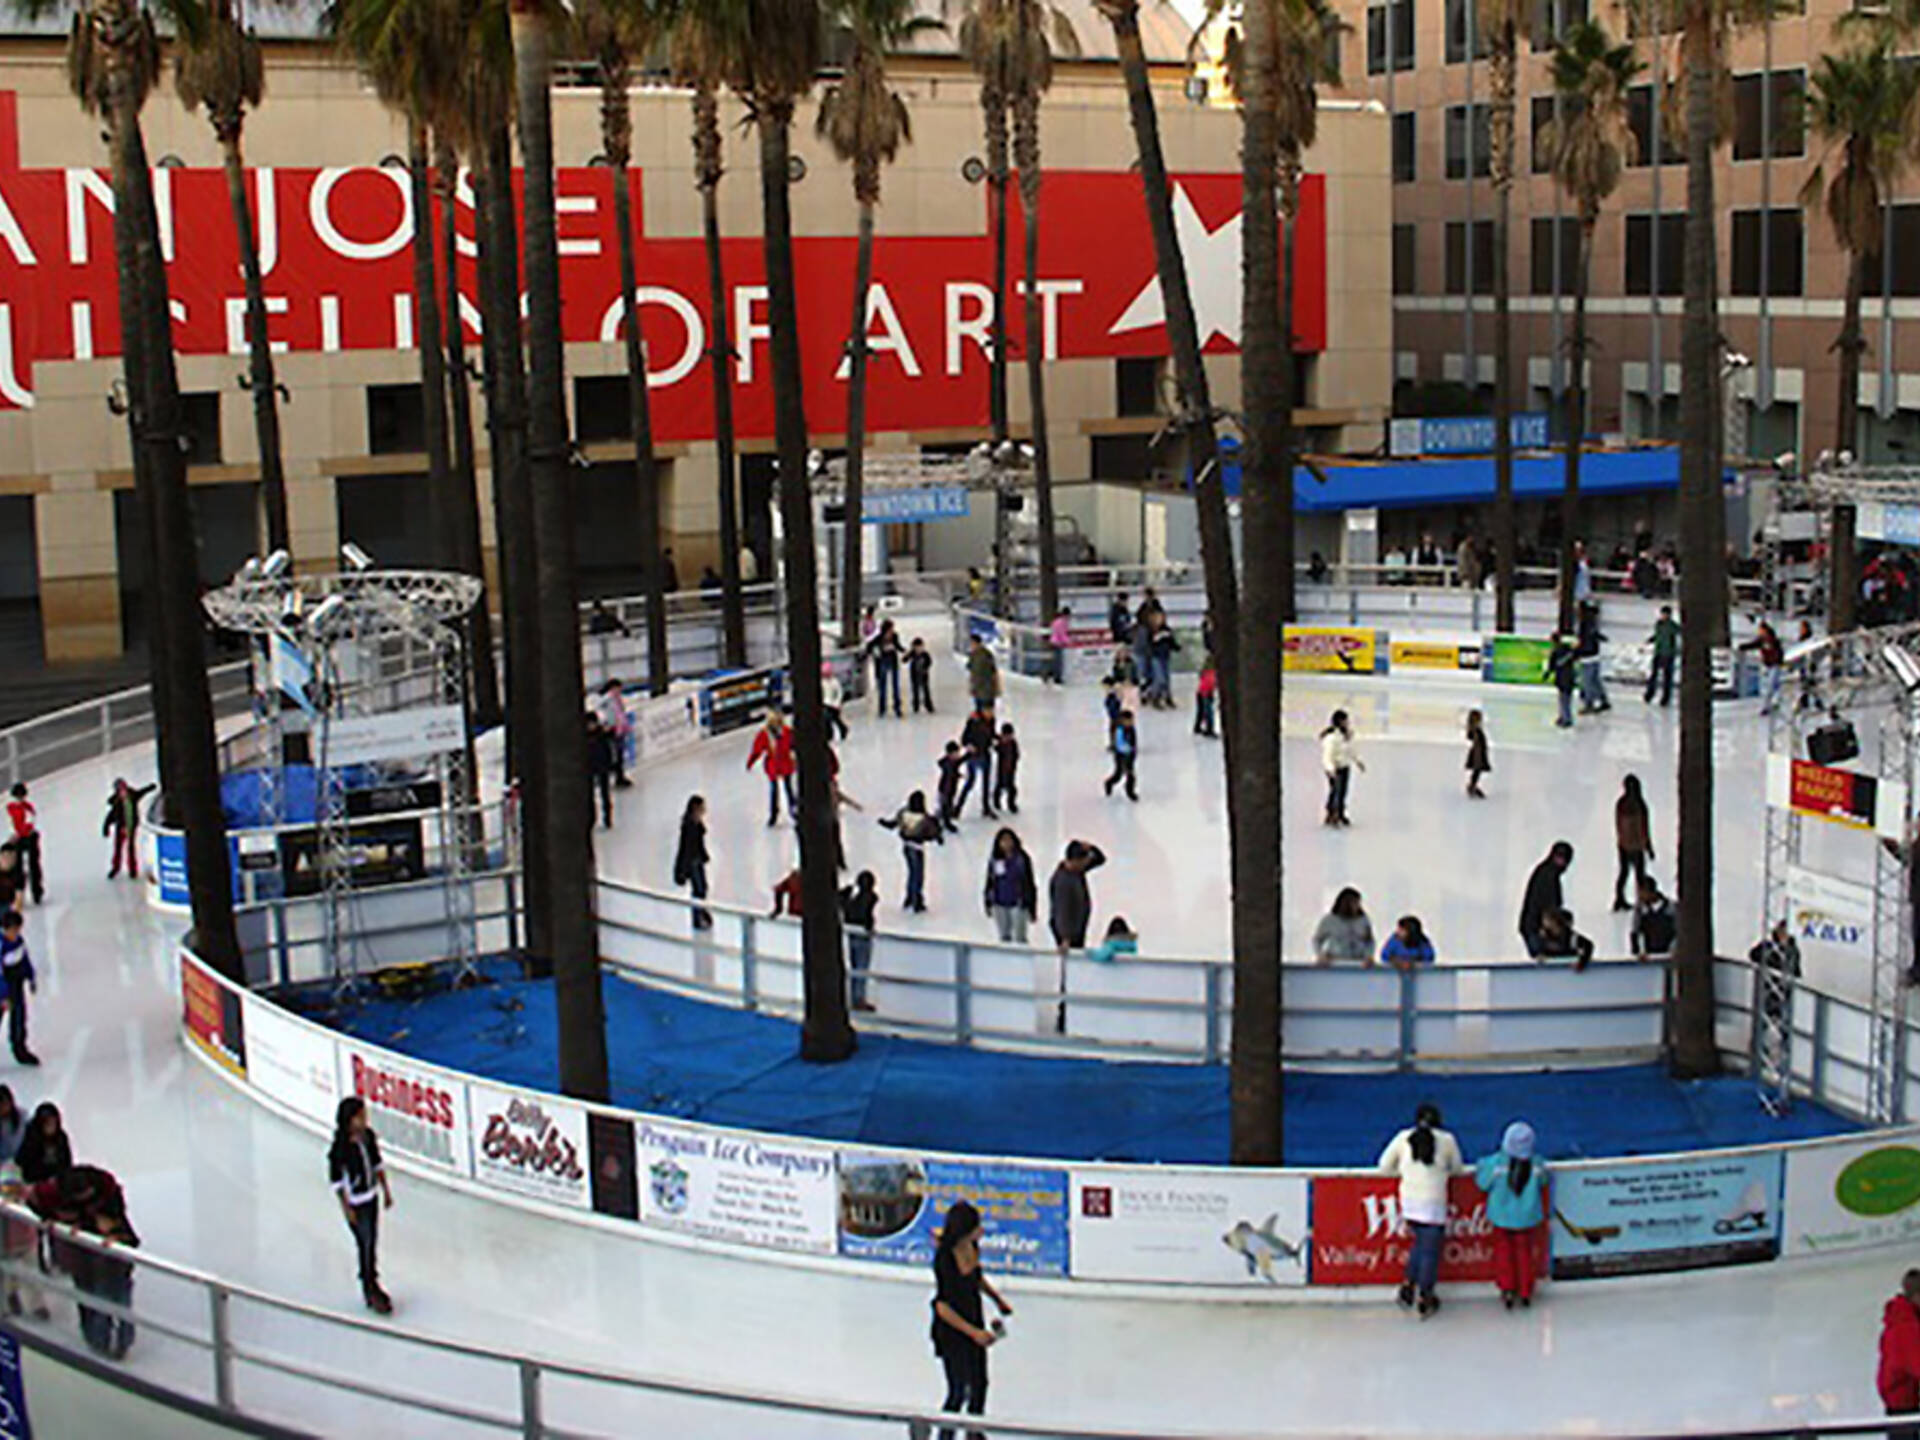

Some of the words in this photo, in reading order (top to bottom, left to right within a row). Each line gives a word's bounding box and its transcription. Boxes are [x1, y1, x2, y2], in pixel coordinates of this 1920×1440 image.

[600, 285, 771, 387] OF
[834, 280, 1083, 380] ART
[1424, 417, 1518, 449] DOWNTON
[639, 1124, 707, 1156] Penguin
[713, 1138, 741, 1162] Ice
[743, 1142, 832, 1181] Company
[1318, 1244, 1381, 1271] Valley
